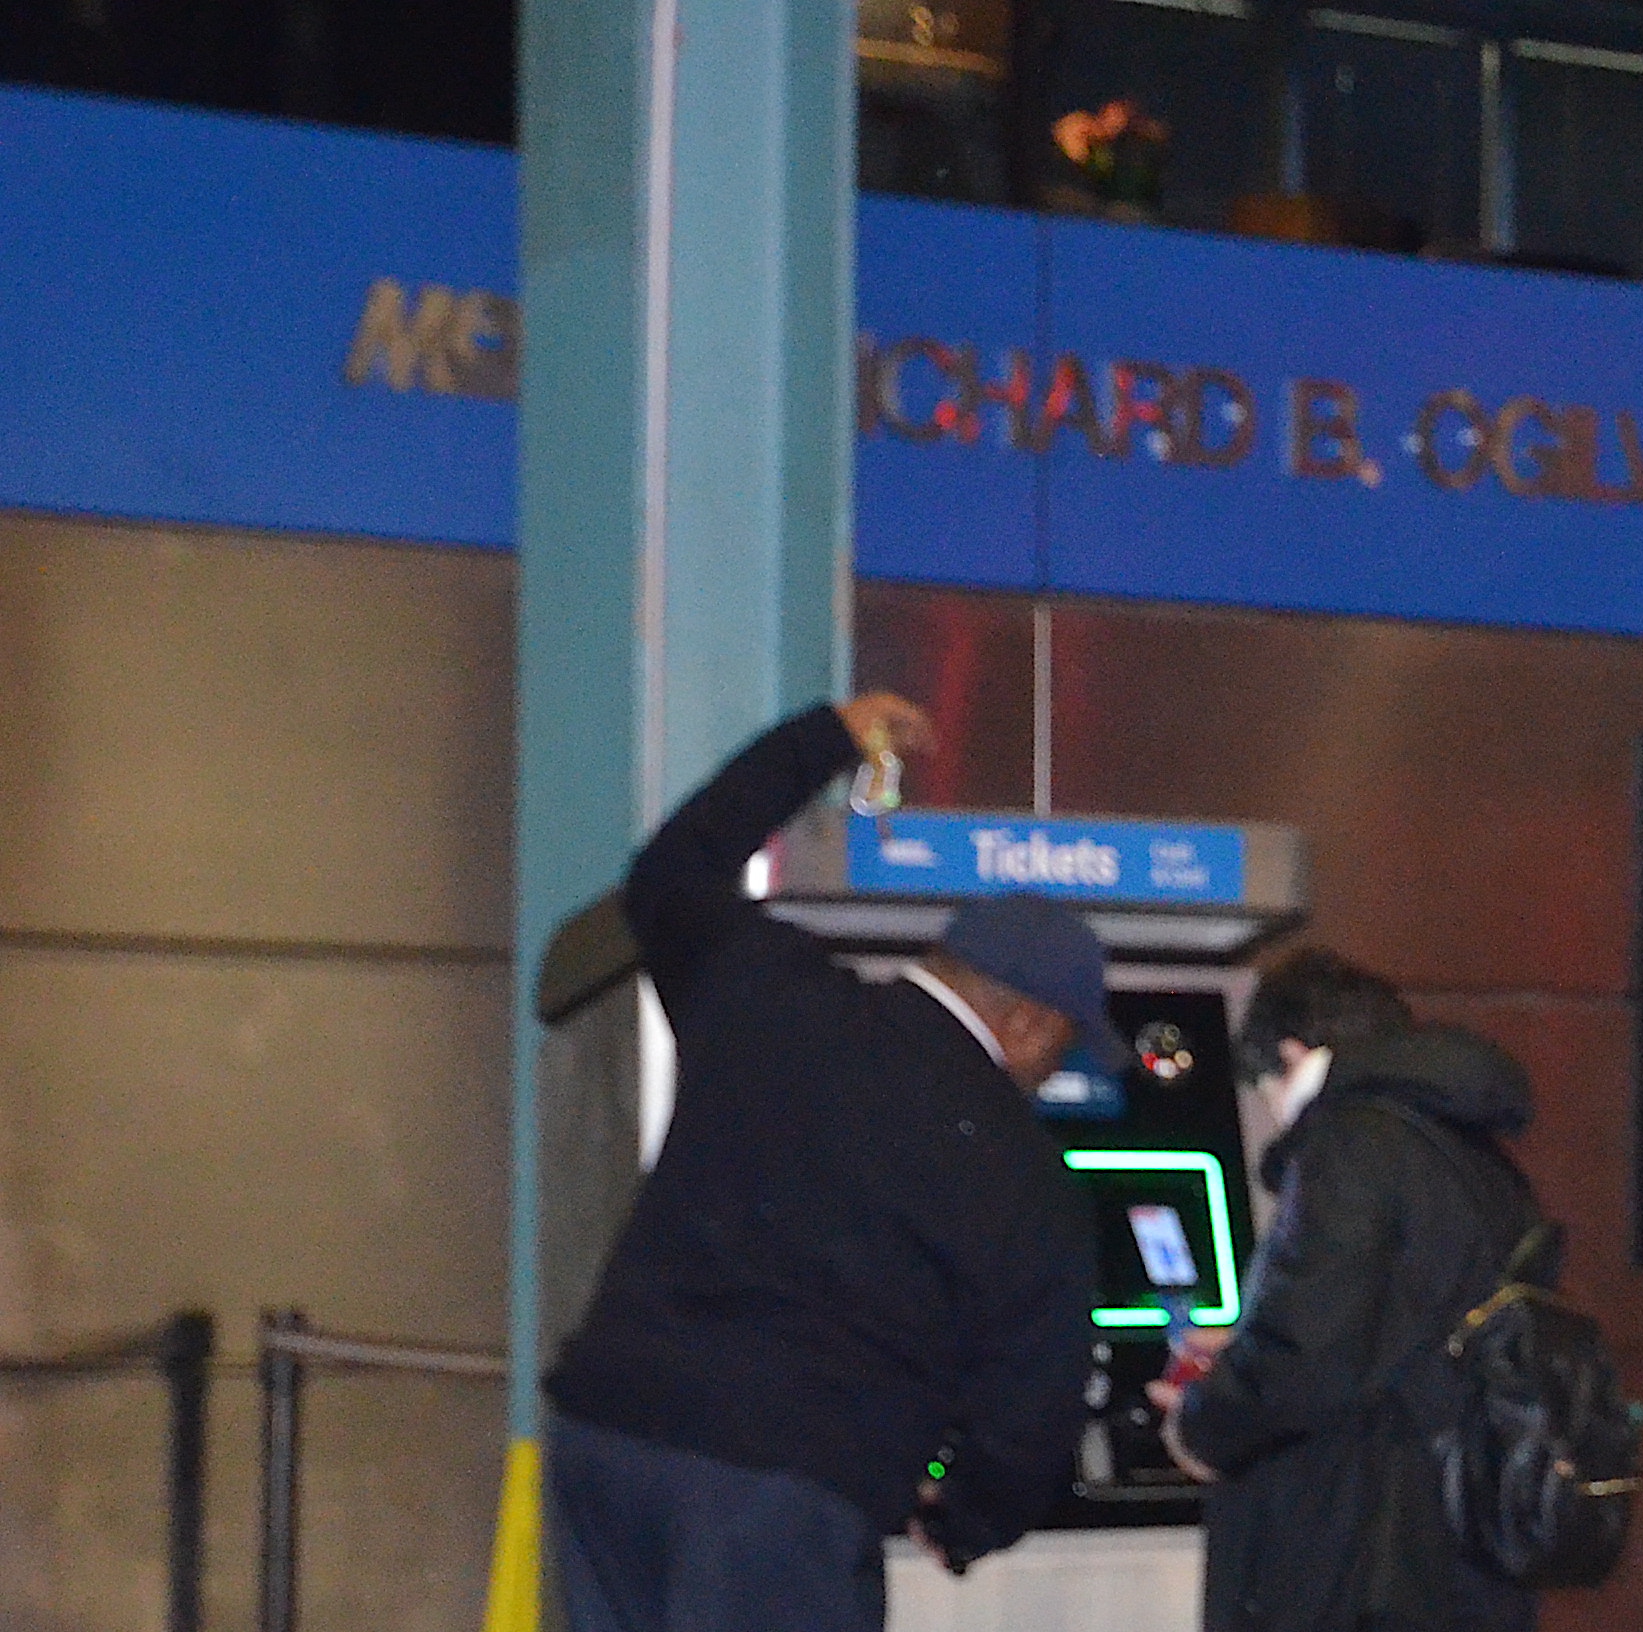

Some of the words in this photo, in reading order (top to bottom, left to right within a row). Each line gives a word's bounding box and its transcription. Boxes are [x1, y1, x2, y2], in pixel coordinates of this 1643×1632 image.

[855, 331, 1257, 466] ICHARD
[1286, 376, 1383, 488] B.
[968, 827, 1121, 888] Tickets
